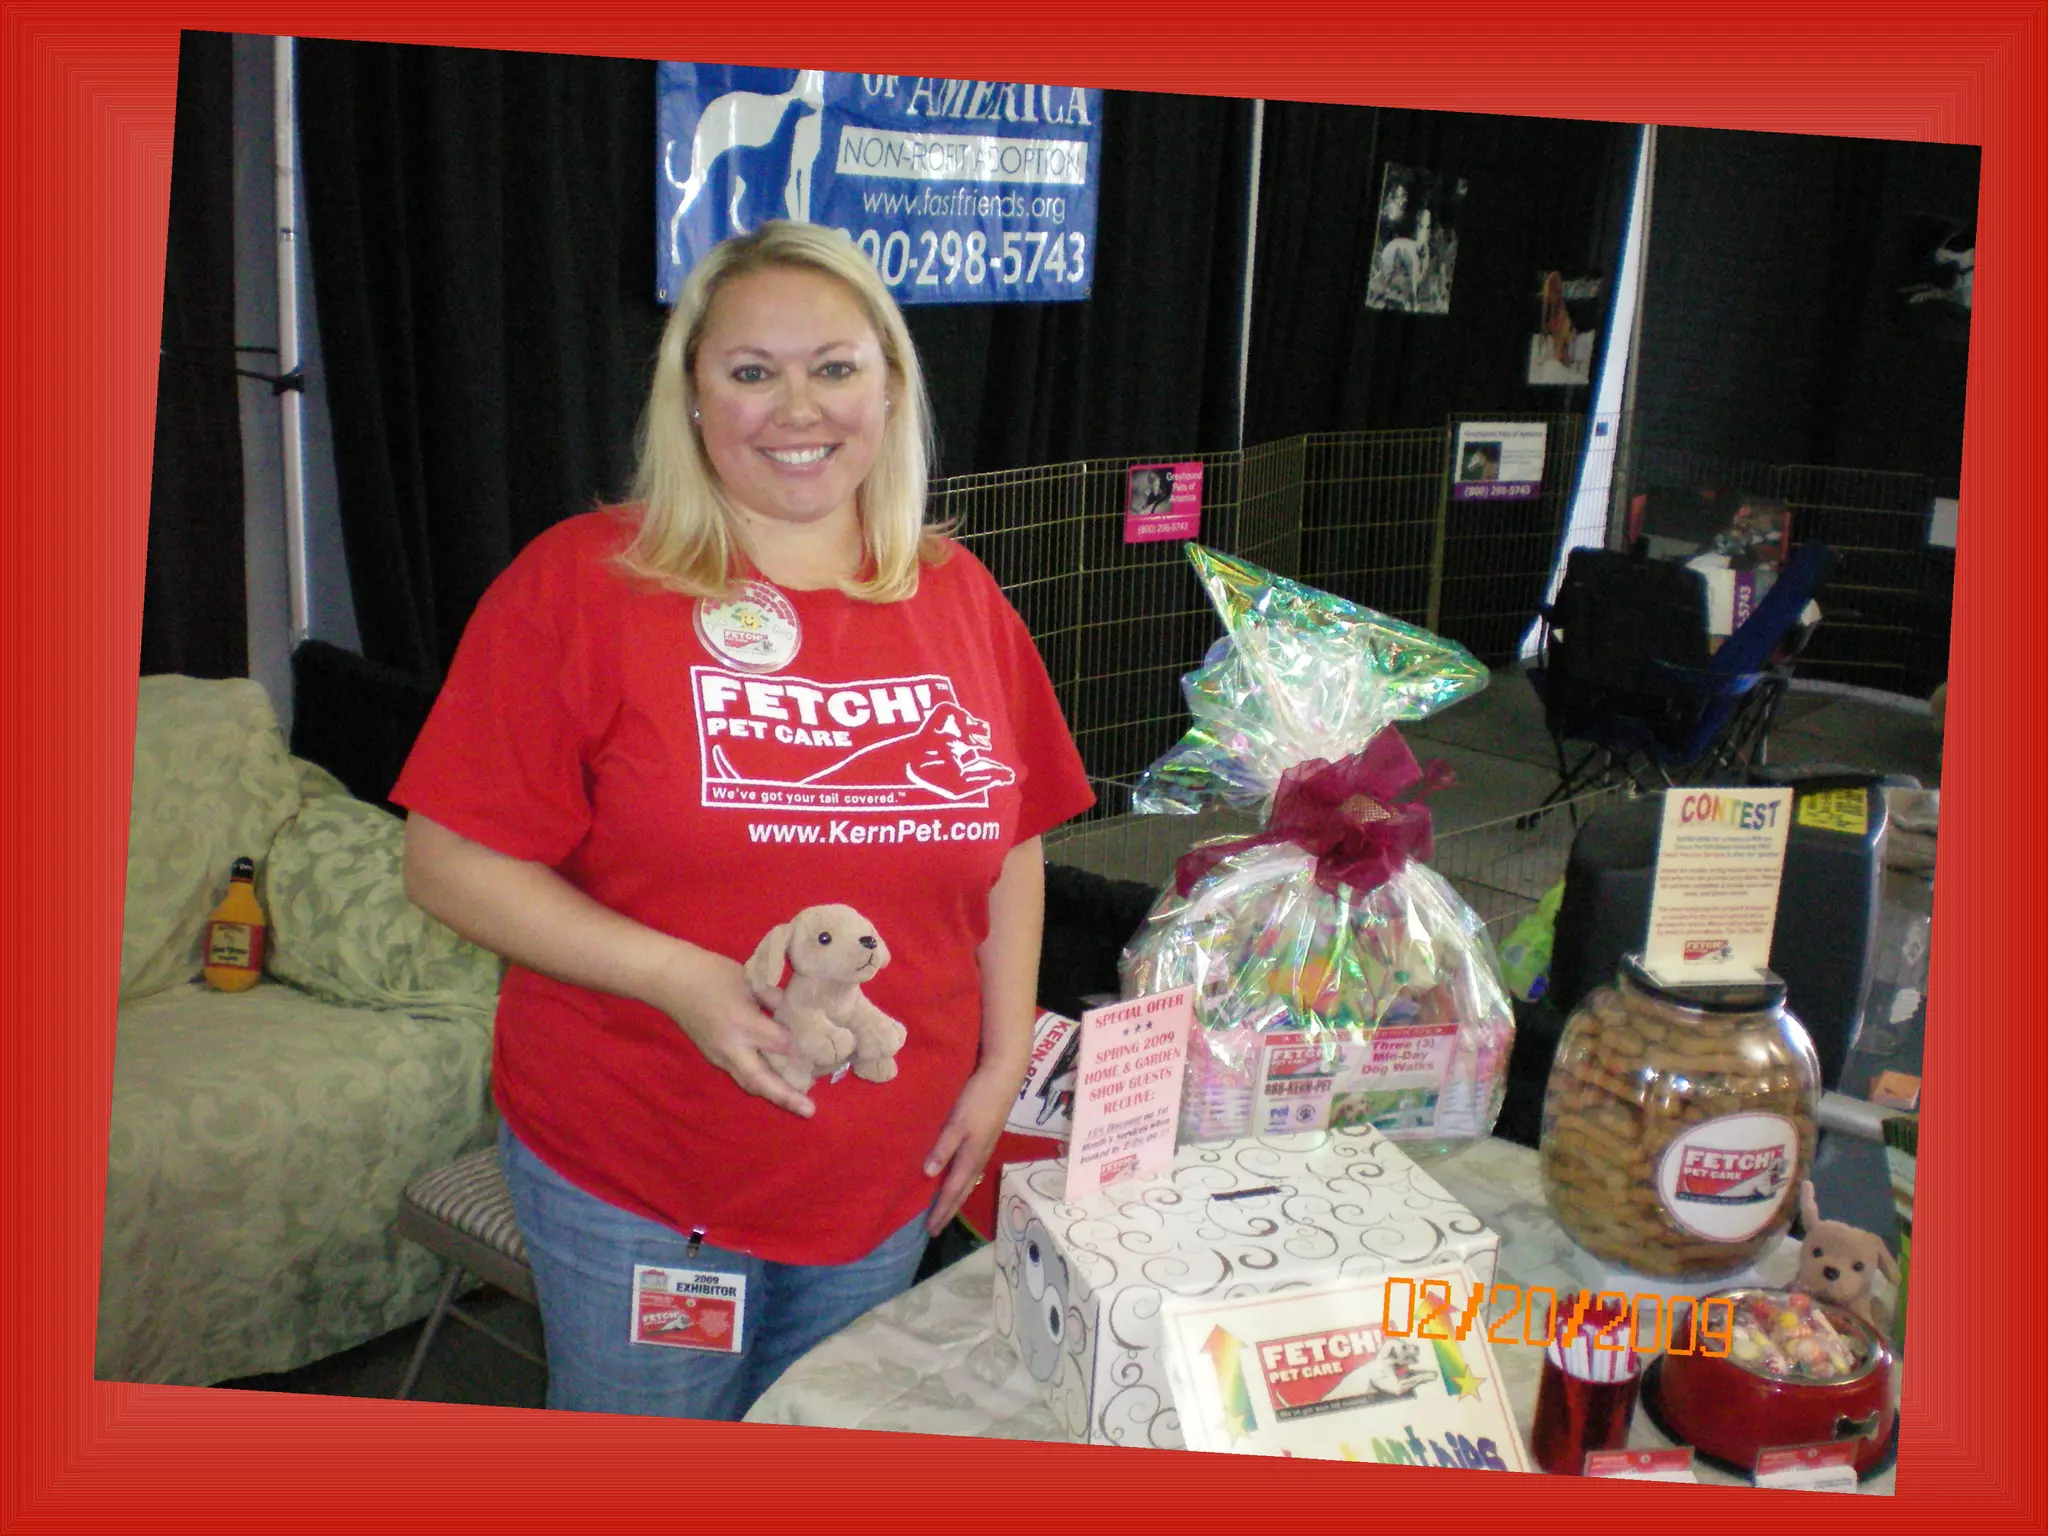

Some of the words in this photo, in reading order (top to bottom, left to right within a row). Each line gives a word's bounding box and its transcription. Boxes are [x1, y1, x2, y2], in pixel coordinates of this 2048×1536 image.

[863, 187, 1066, 223] www.fastfriends.org
[838, 227, 1087, 287] 00-298-5743
[700, 674, 933, 729] FETCH!
[707, 717, 768, 737] PET
[774, 723, 853, 747] CARE
[712, 786, 756, 801] We've
[761, 790, 783, 804] got
[786, 791, 816, 805] your
[819, 791, 839, 803] tail
[1680, 792, 1782, 831] CONTEST
[748, 819, 1001, 845] www.KernPet.com
[1095, 1005, 1141, 1028] SPECIAL
[1147, 993, 1184, 1014] OFFER
[1095, 1042, 1140, 1064] SPRING
[1143, 1031, 1175, 1050] 2009
[1372, 1041, 1413, 1051] Three
[1084, 1064, 1120, 1086] HOME
[1122, 1062, 1131, 1074] &
[1135, 1047, 1181, 1069] GARDEN
[1361, 1064, 1389, 1076] Dog
[1089, 1080, 1125, 1102] SHOW
[1128, 1066, 1173, 1089] GUESTS
[1683, 1166, 1709, 1177] PET
[1710, 1170, 1743, 1180] CARE
[676, 1282, 737, 1298] EXHIBITOR
[694, 1274, 720, 1285] 2009
[1261, 1328, 1384, 1370] FETCH!
[1269, 1370, 1298, 1384] PET
[1301, 1362, 1343, 1379] CARE
